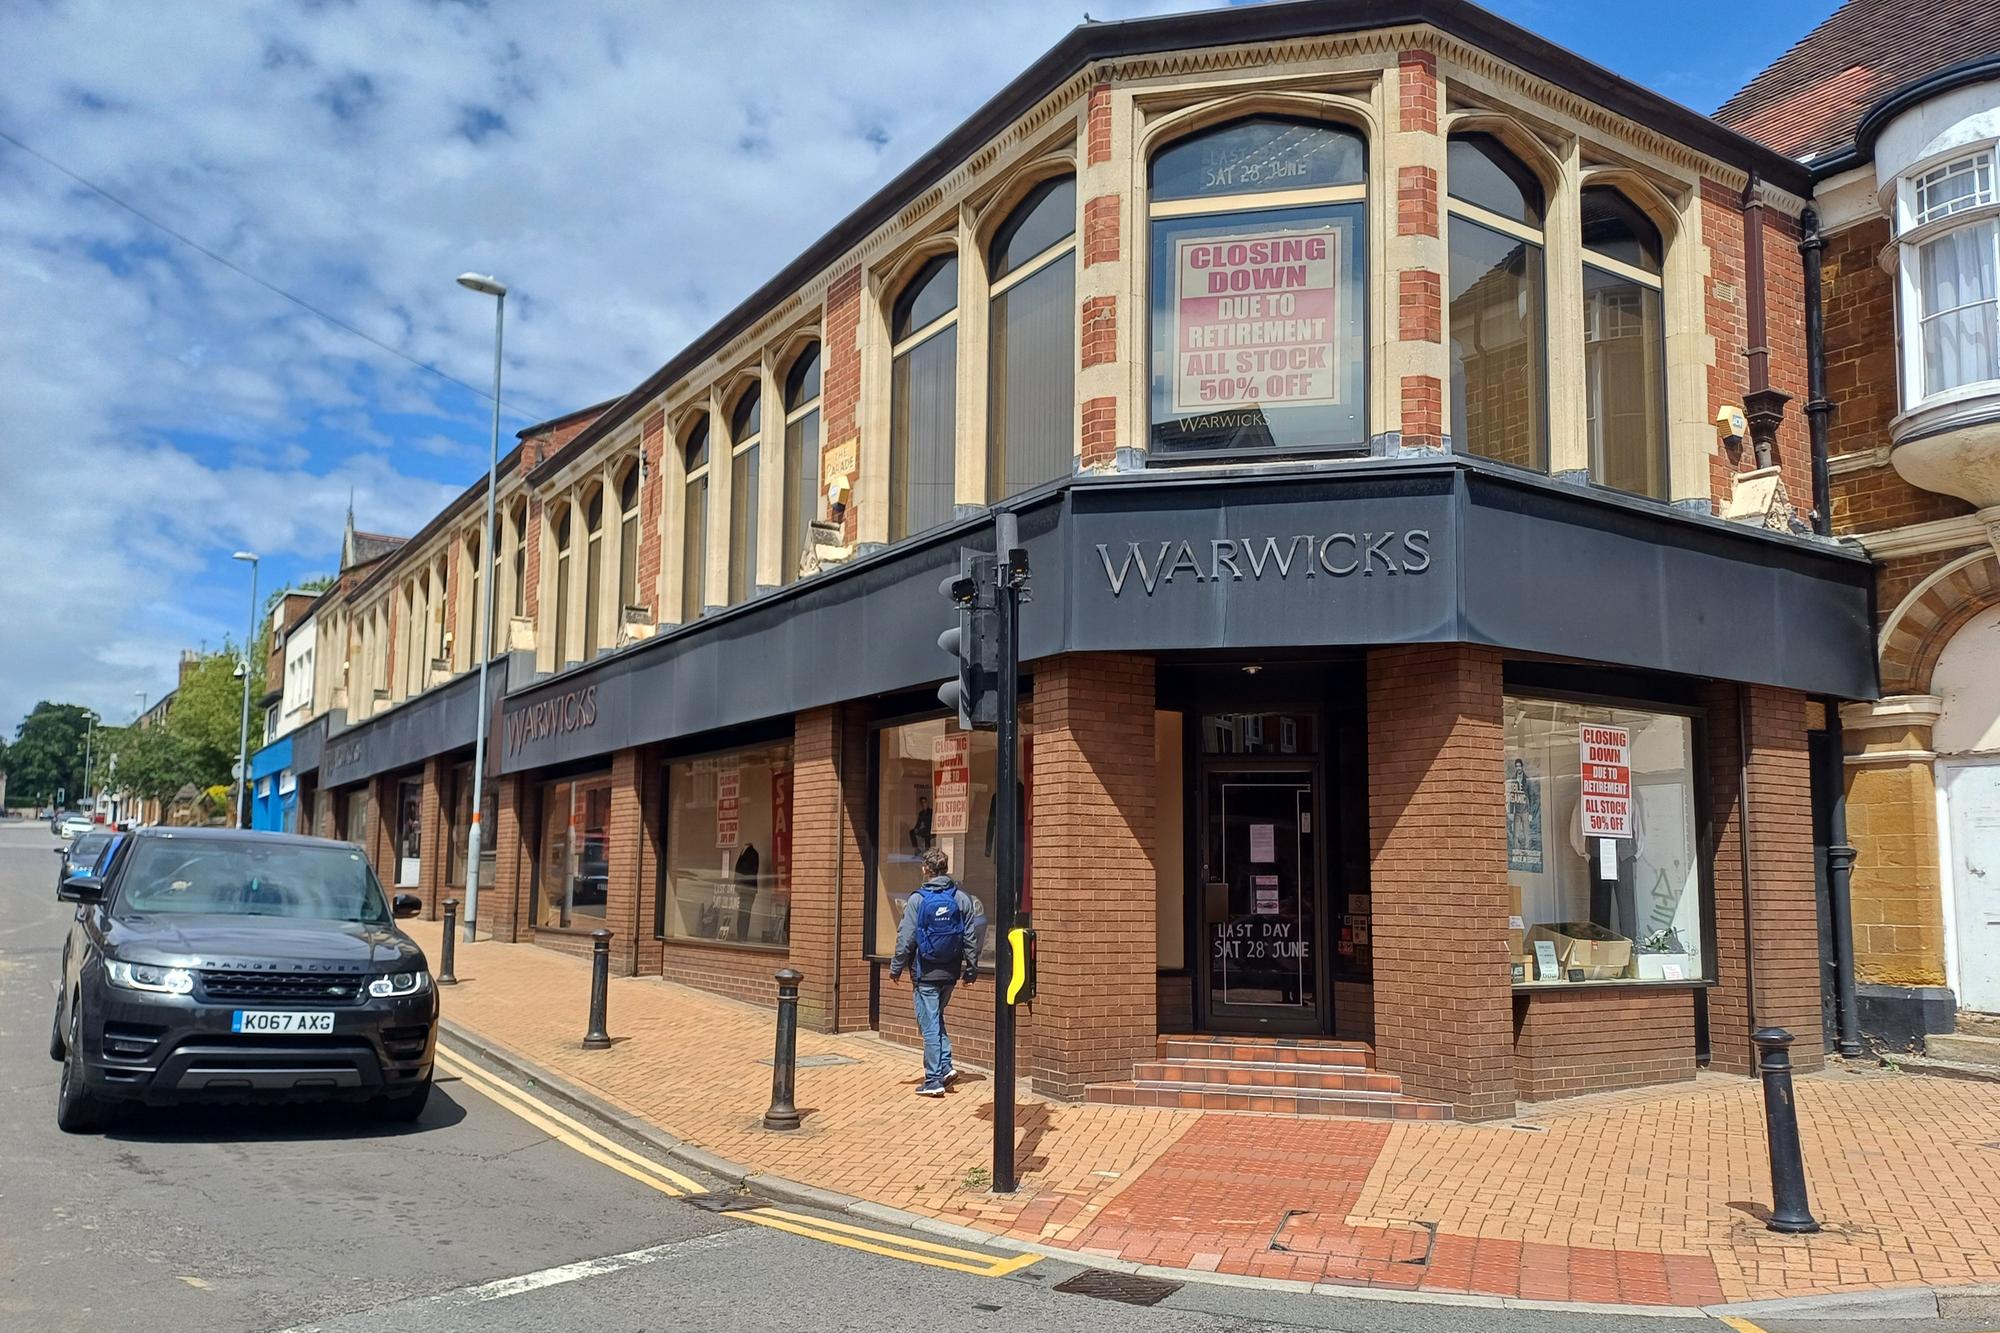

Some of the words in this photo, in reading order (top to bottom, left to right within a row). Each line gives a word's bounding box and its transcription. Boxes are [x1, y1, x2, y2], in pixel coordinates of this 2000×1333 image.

[1206, 165, 1235, 187] SAT
[1240, 164, 1260, 183] 28
[1266, 159, 1308, 181] JUNE
[1190, 238, 1326, 269] CLOSING
[1208, 265, 1307, 294] DOWN
[1218, 295, 1261, 321] DUE
[1267, 293, 1296, 317] TO
[1188, 318, 1326, 349] RETIREMENT
[1187, 351, 1230, 377] ALL
[1236, 347, 1327, 373] STOCK
[1200, 376, 1260, 401] 50%
[1266, 373, 1313, 397] OFF
[1179, 413, 1272, 433] WARWICKS
[1095, 529, 1432, 597] WARWICKS
[507, 686, 598, 758] WARWICKS
[934, 737, 967, 753] CLOSING
[1582, 728, 1627, 747] CLOSING
[940, 753, 963, 768] DOWN
[1589, 746, 1621, 763] DOWN
[1592, 765, 1607, 779] DUE
[1607, 765, 1618, 779] TO
[1583, 780, 1628, 795] RETIREMENT
[945, 800, 966, 813] STOCK
[1585, 798, 1600, 814] ALL
[1600, 800, 1627, 815] STOCK
[937, 815, 951, 828] 50%
[951, 814, 963, 828] OFF
[1590, 815, 1609, 830] 50%
[1610, 816, 1624, 831] OFF
[775, 777, 787, 889] SALE
[1218, 923, 1254, 938] LAST
[1263, 923, 1291, 938] DAY
[1214, 940, 1243, 959] SAT
[1272, 941, 1309, 958] JUNE
[206, 961, 277, 970] RANGE
[293, 964, 360, 972] ROVER
[244, 1014, 293, 1030] KO67
[297, 1015, 331, 1030] AXG
